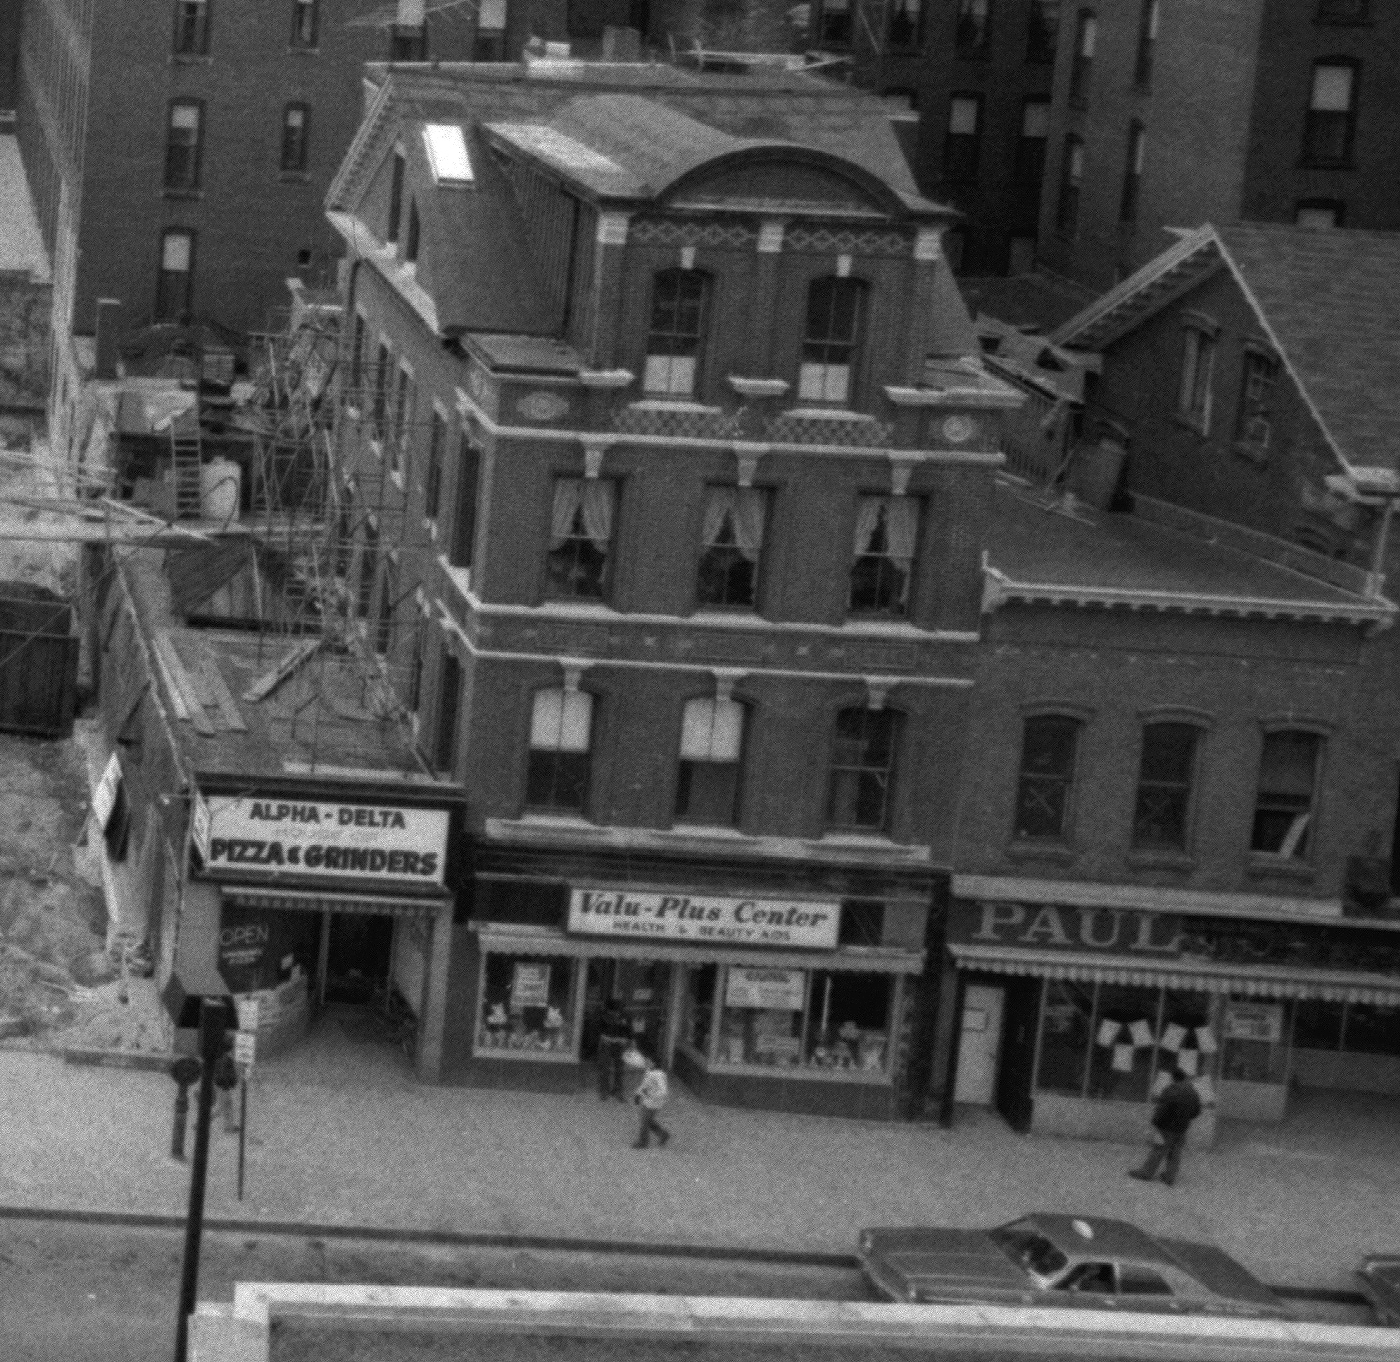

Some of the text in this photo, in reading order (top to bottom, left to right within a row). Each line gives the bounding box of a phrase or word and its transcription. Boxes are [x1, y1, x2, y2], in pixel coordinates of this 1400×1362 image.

[250, 802, 320, 824] ALPHA
[338, 807, 406, 830] DELTA
[211, 838, 284, 866] PIZZA
[304, 844, 439, 876] GRINDERS
[580, 891, 829, 928] Valu-Plus Center
[220, 924, 270, 946] OPEN
[613, 920, 666, 933] HEALTH
[700, 925, 755, 938] BEAUTY
